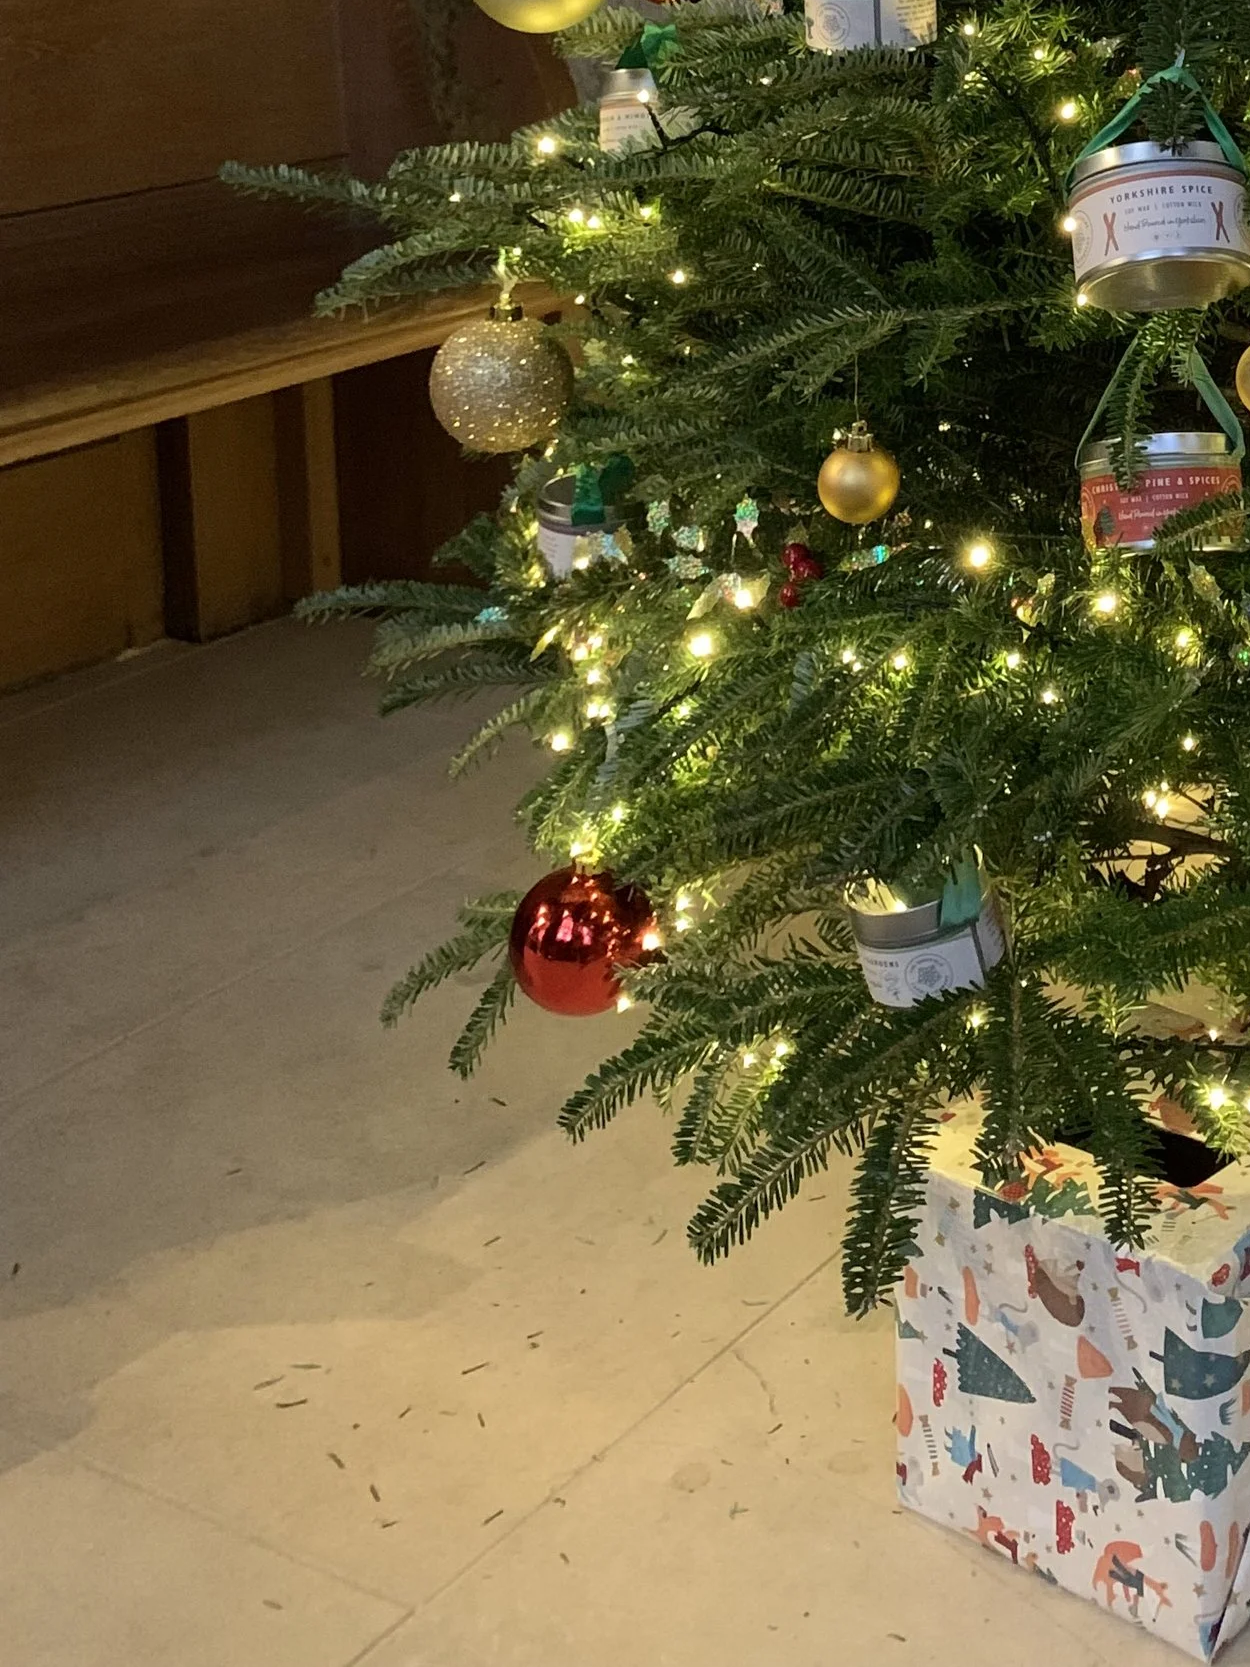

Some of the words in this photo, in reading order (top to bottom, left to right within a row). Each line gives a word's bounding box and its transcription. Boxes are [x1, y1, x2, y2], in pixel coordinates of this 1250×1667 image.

[1109, 184, 1175, 204] YORKSHIRE
[1181, 184, 1214, 195] SPICE
[1145, 476, 1171, 488] PINE
[1177, 476, 1184, 486] &
[1188, 475, 1221, 486] SPICES
